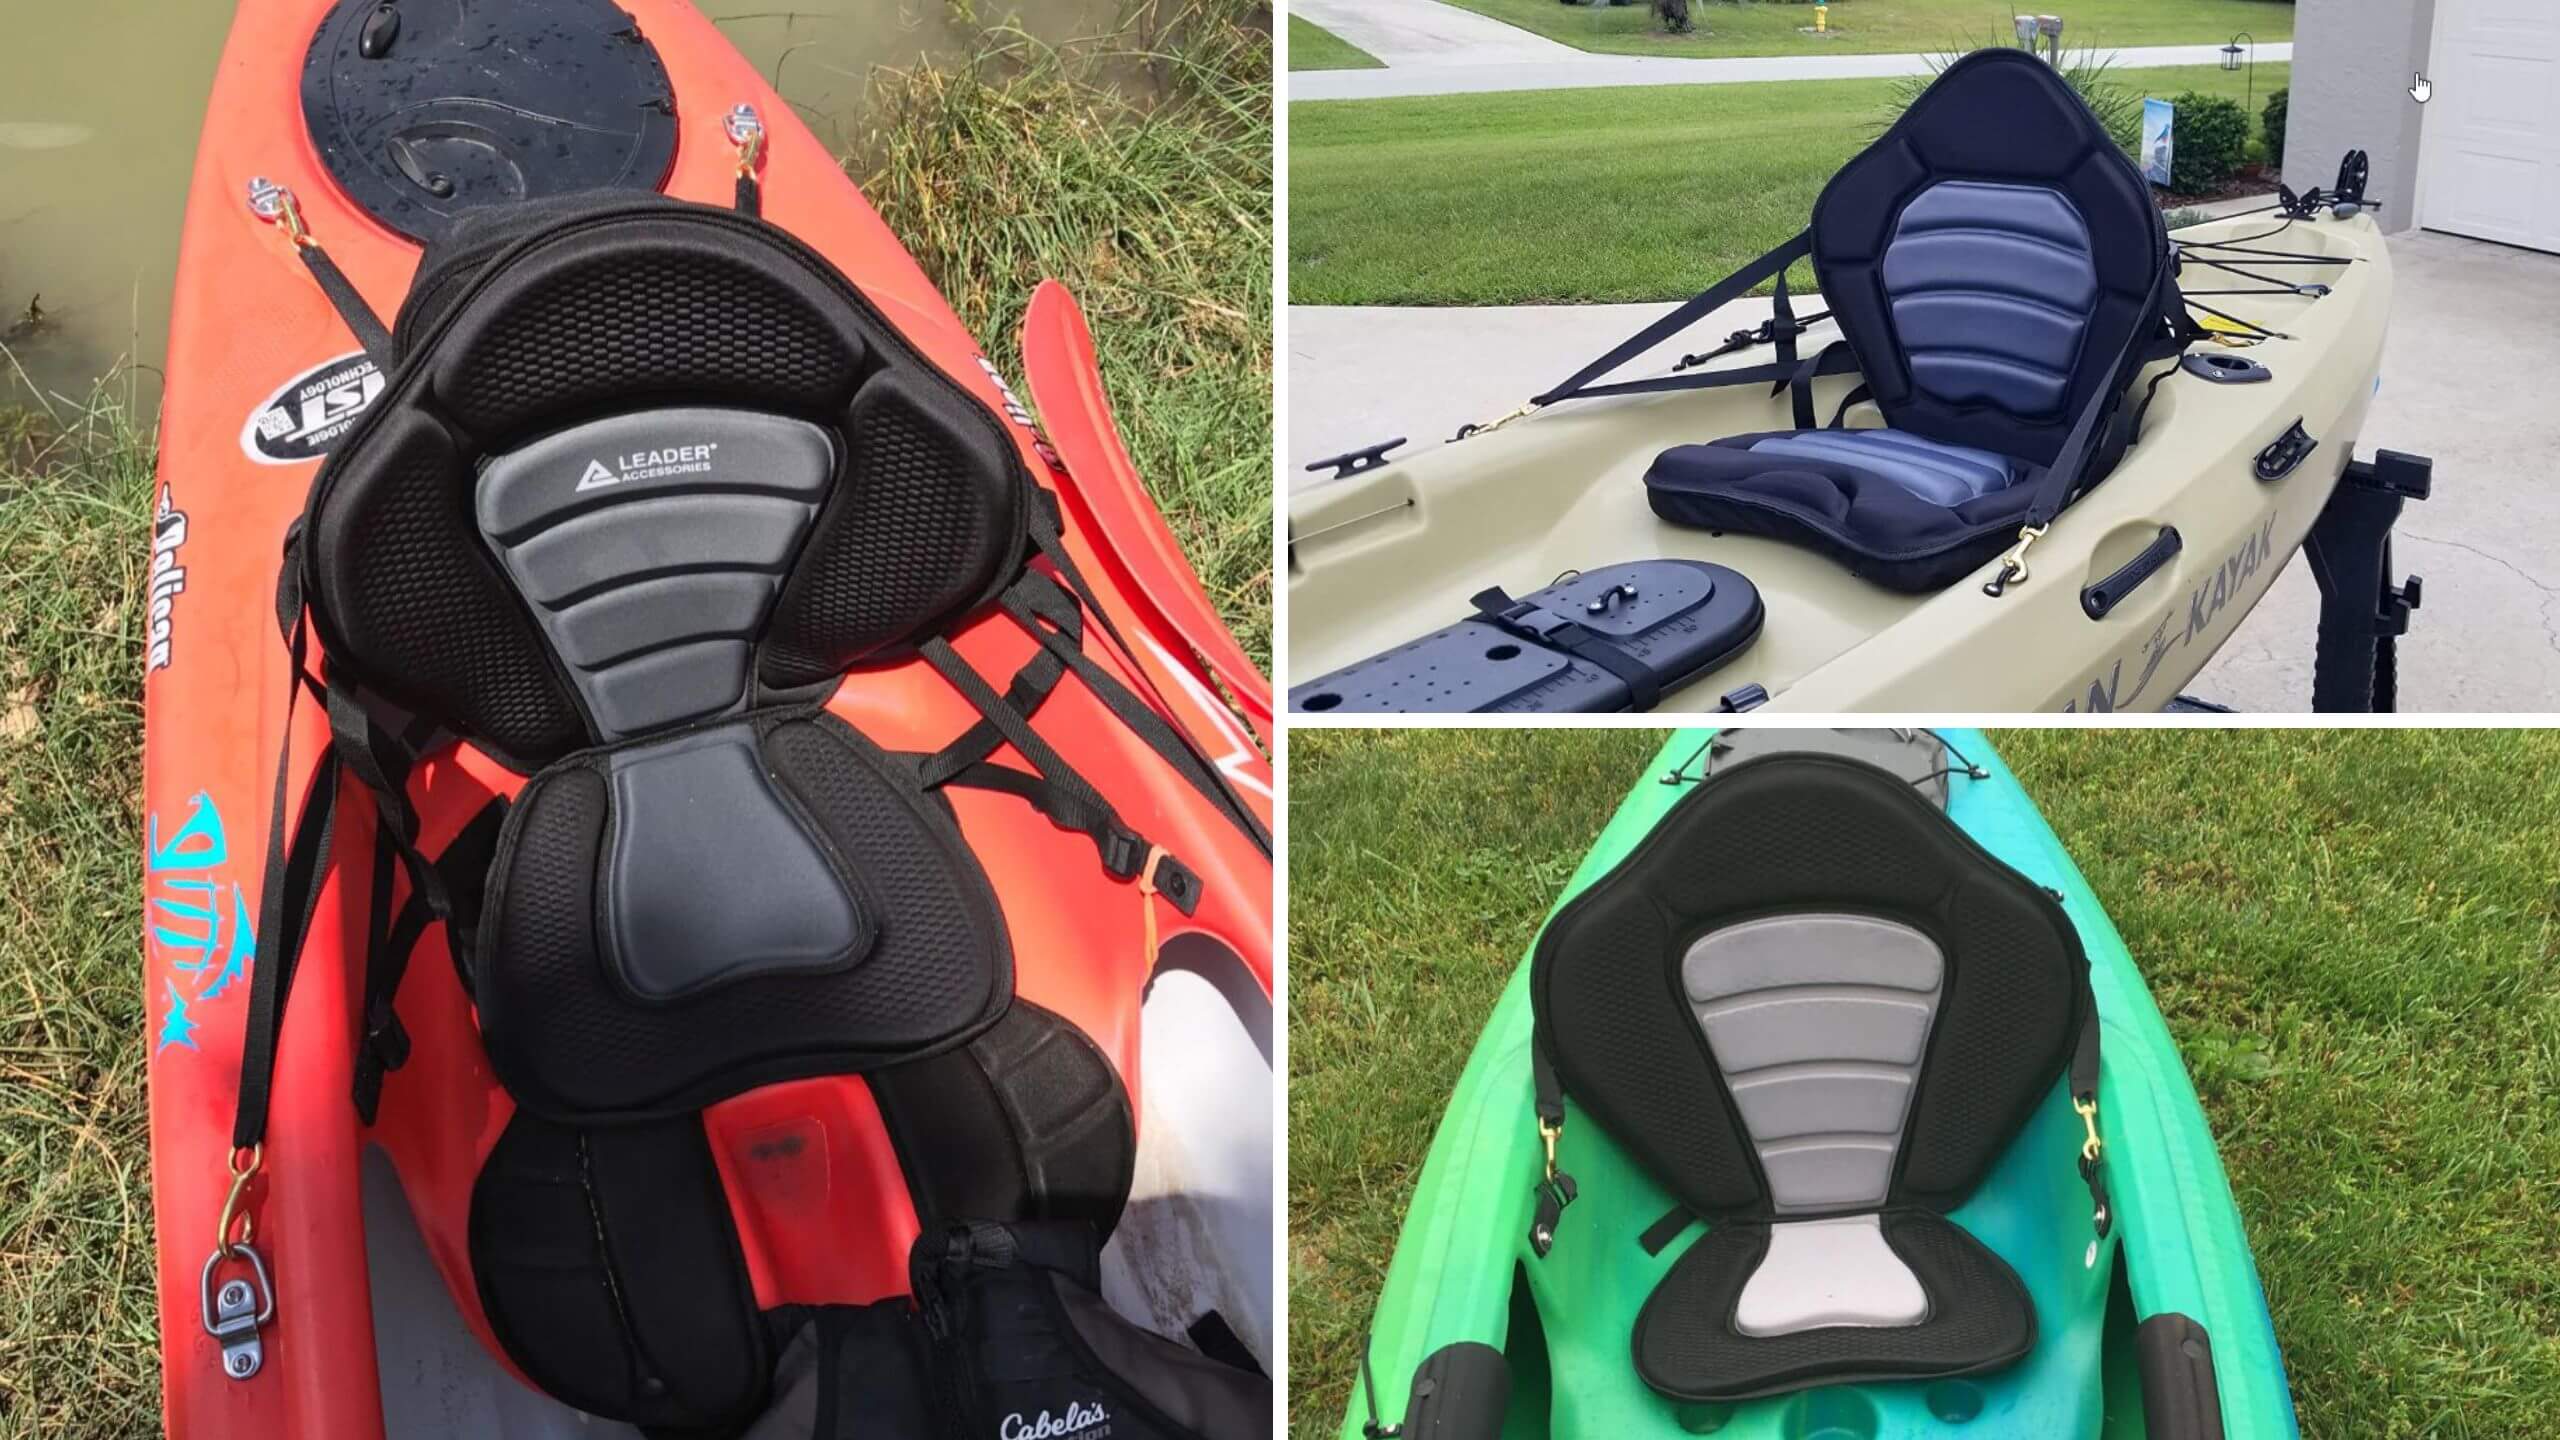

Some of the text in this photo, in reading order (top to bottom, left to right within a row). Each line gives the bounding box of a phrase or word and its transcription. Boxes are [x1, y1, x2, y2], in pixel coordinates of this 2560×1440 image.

[300, 361, 378, 400] ECHNOLOGY
[618, 443, 710, 471] LEADER
[622, 461, 711, 482] ACCESSORIES
[2184, 509, 2278, 648] KAYAK
